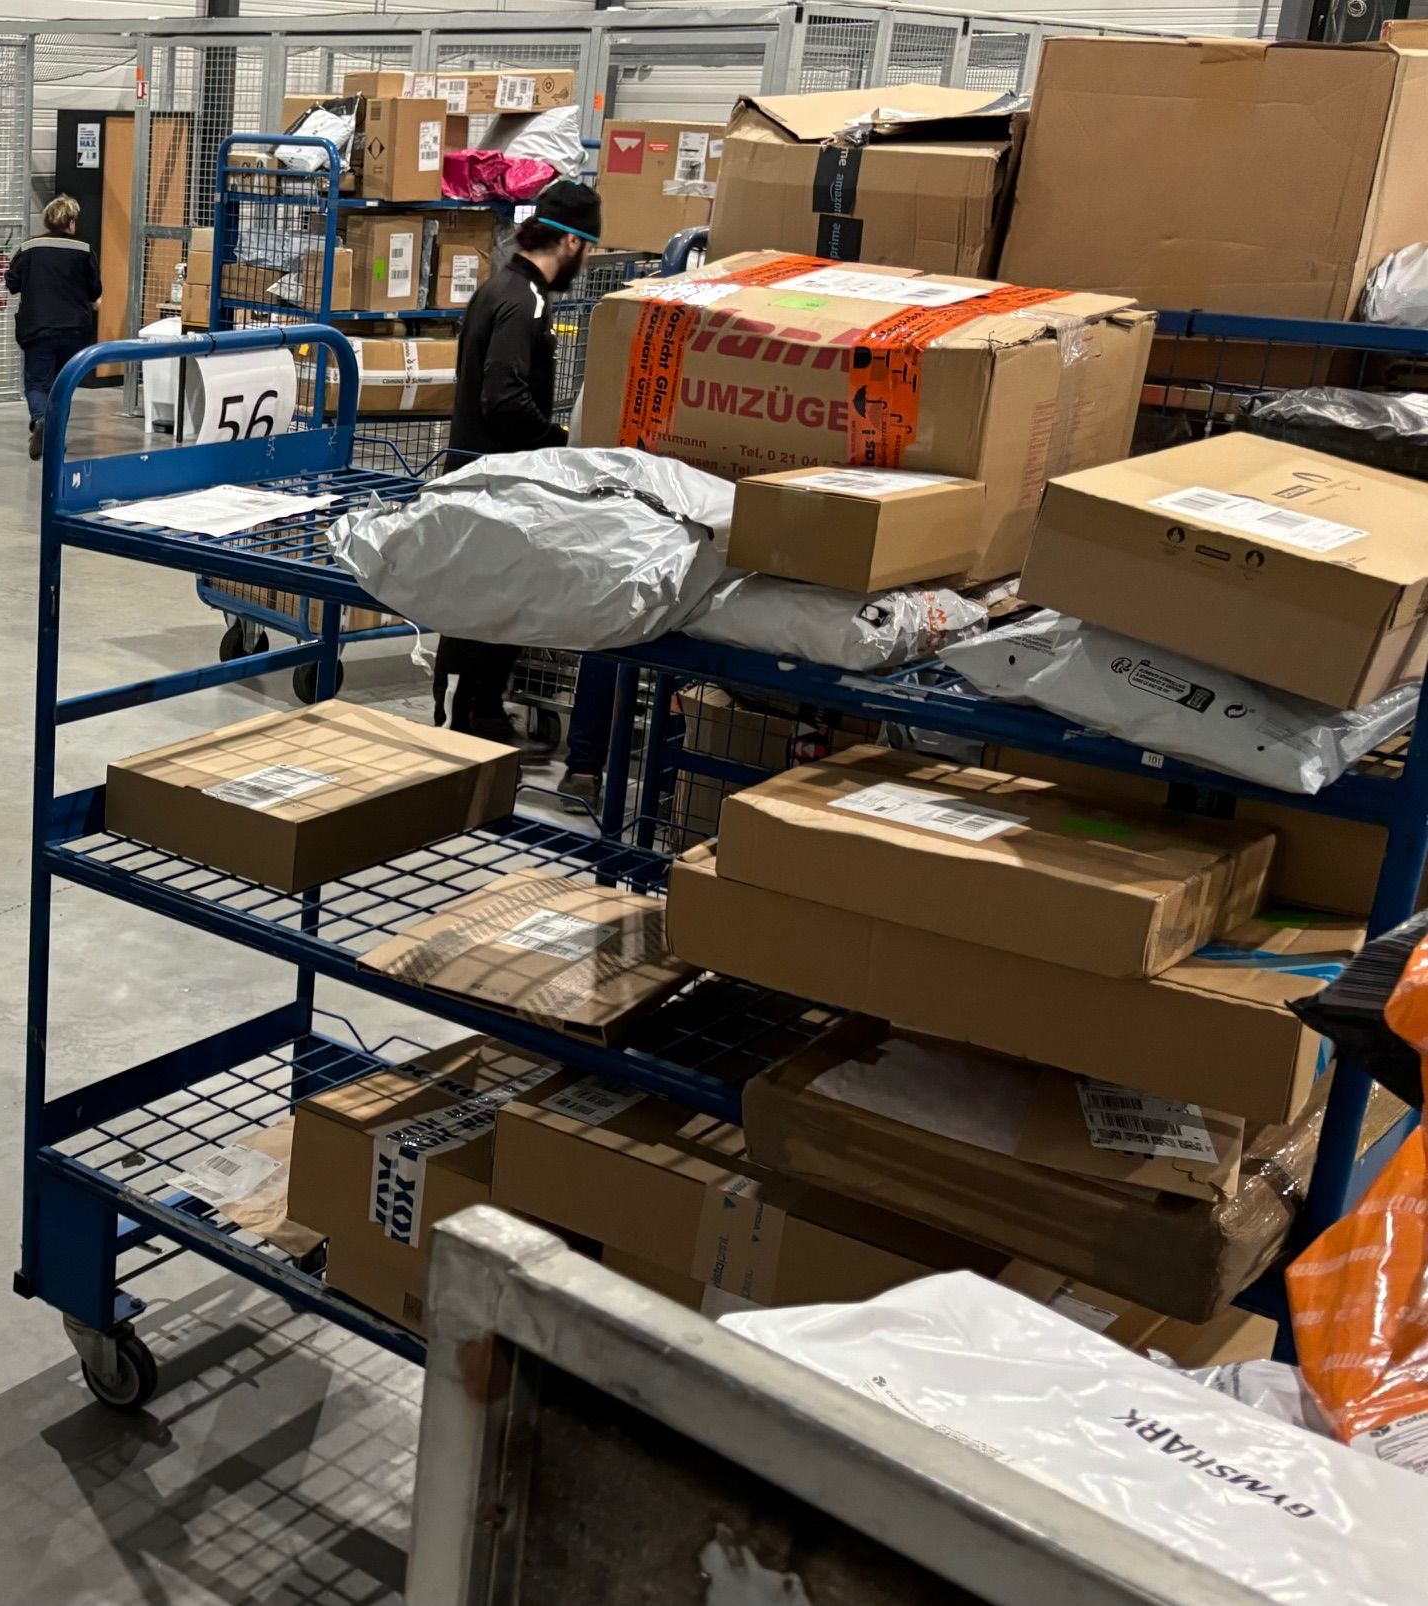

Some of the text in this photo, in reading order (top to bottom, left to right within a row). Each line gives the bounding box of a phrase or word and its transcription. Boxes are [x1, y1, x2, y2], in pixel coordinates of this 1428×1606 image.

[833, 173, 846, 217] amazon
[828, 222, 842, 259] prime
[659, 303, 686, 370] Vorsicht
[216, 388, 279, 442] 56
[651, 374, 669, 414] Glas
[679, 377, 849, 433] UMZÜGE
[1110, 1409, 1317, 1520] GYMSHARK
